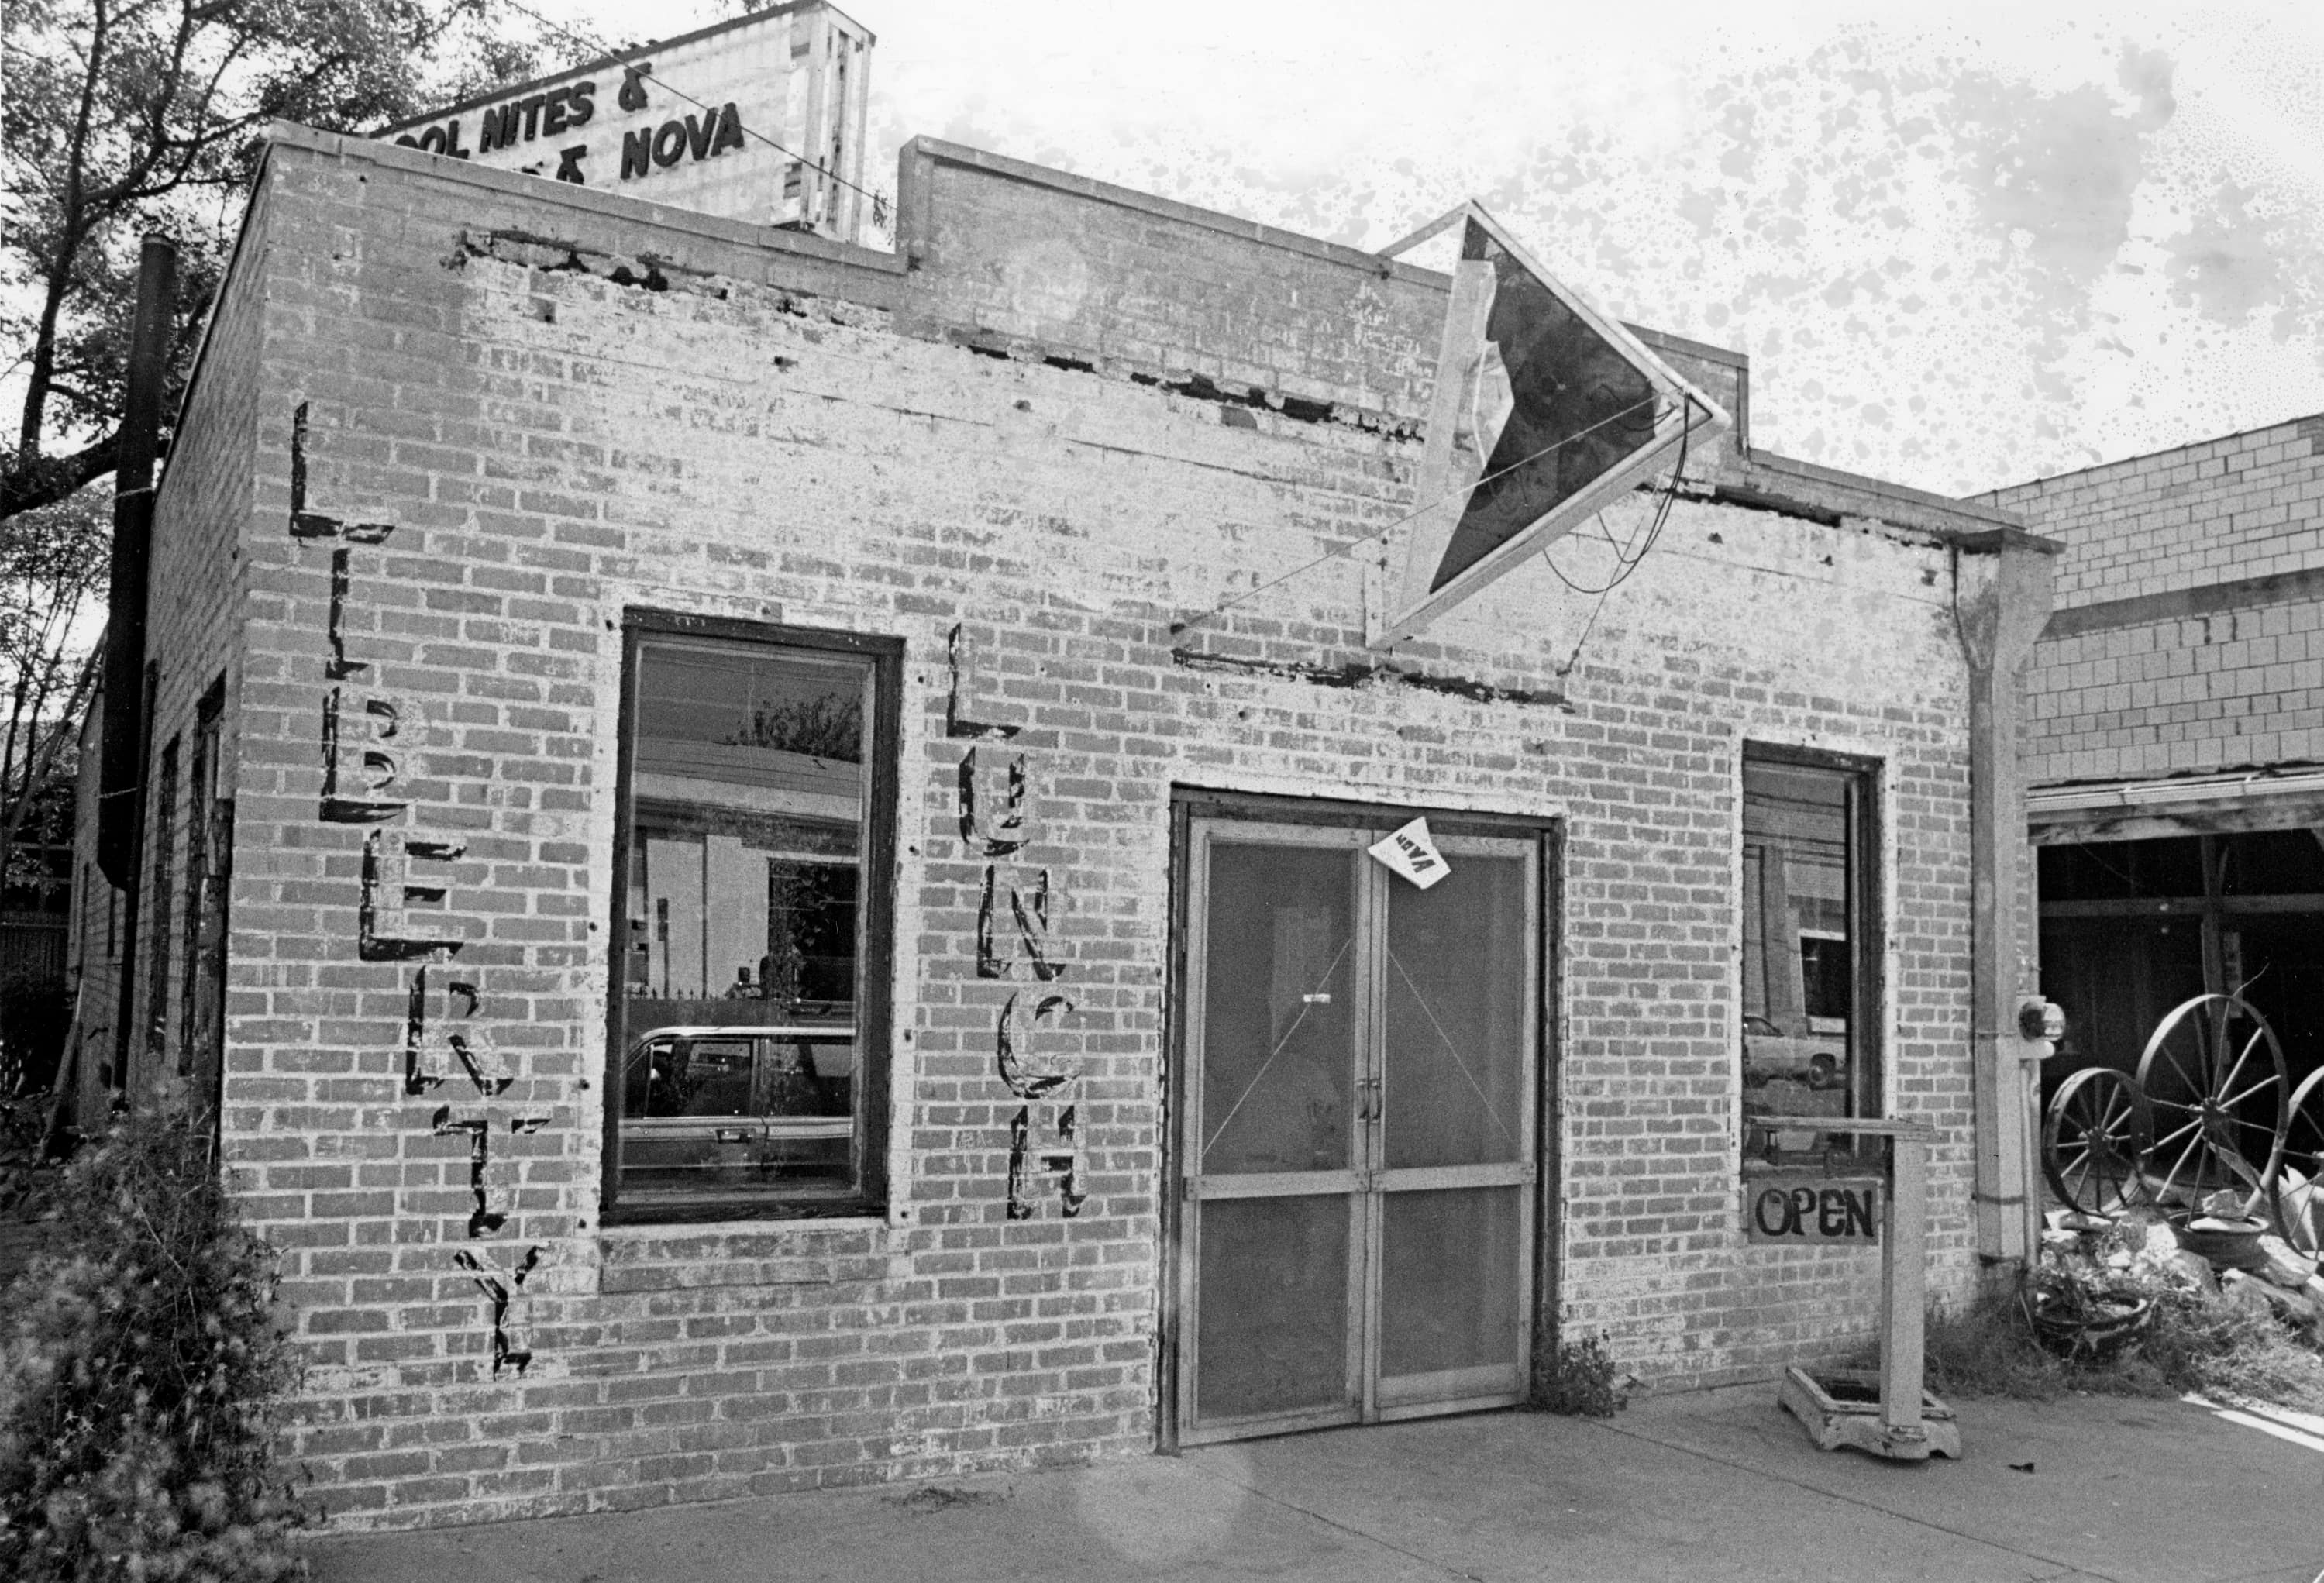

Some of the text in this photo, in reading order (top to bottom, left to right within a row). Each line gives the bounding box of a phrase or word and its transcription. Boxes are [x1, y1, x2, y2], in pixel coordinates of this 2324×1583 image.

[394, 61, 652, 160] OL NITES &
[620, 102, 745, 180] NOVA
[289, 401, 551, 1381] LIBERTY
[1396, 834, 1436, 873] NOVA
[946, 622, 1086, 1220] LUNCH
[1755, 1187, 1874, 1237] OPEN
